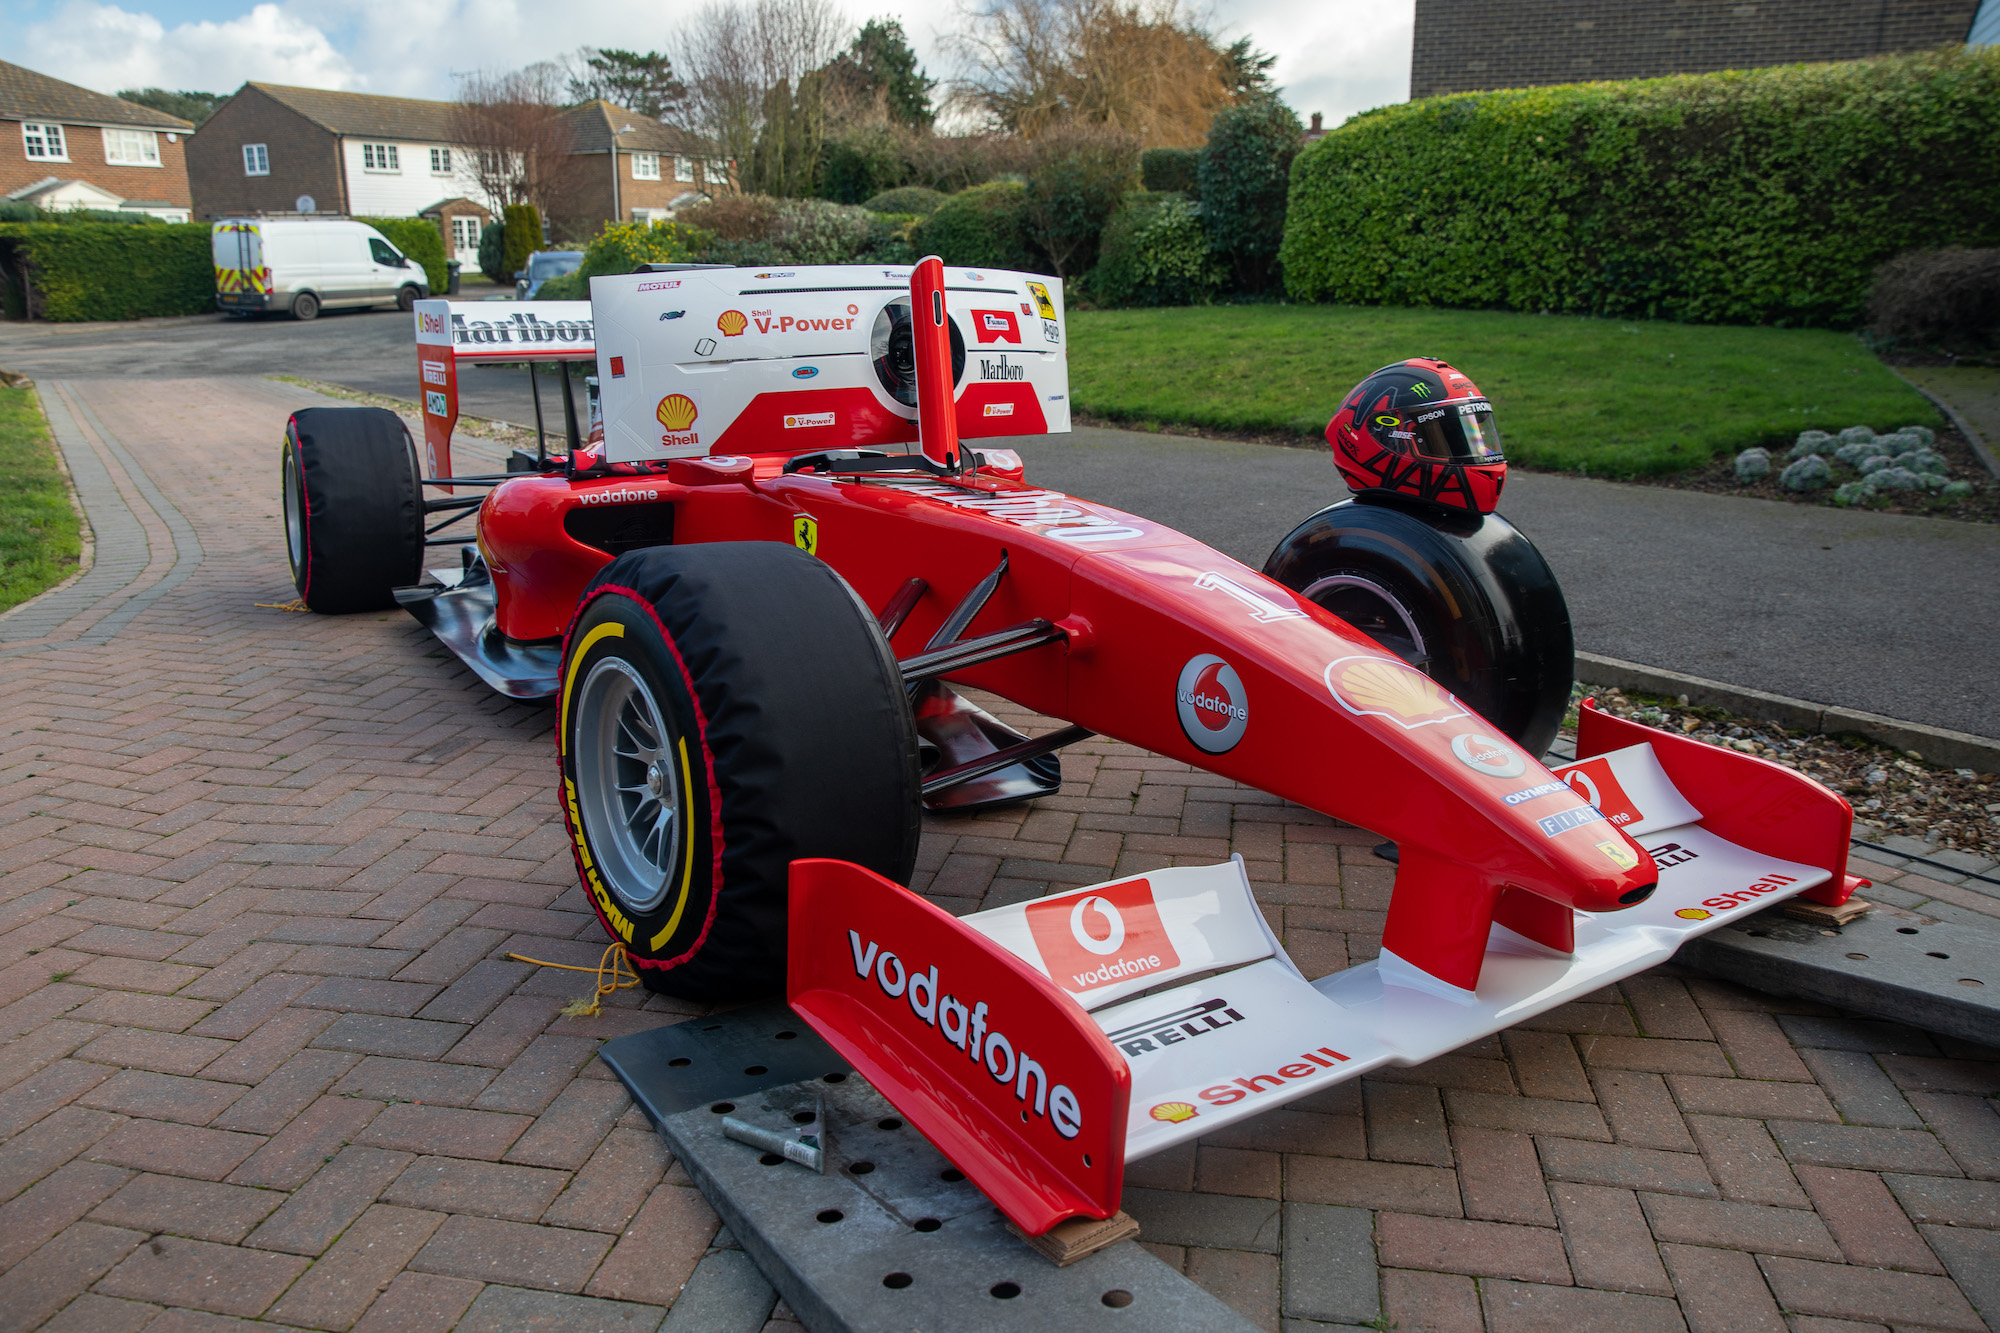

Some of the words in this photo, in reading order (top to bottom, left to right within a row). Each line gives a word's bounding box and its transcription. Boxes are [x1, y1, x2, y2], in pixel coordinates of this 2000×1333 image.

[639, 281, 679, 291] MOTUL
[424, 313, 445, 334] Shell
[752, 309, 772, 317] Shell
[452, 313, 595, 344] arlbor
[754, 316, 854, 334] V-Power
[423, 361, 446, 386] PIRELLI
[980, 355, 1023, 380] Marlboro
[428, 393, 441, 413] AMD
[1458, 402, 1492, 415] PETRON
[1418, 410, 1446, 423] EPSON
[662, 433, 699, 446] Shell
[1388, 430, 1416, 440] BOSE
[579, 487, 658, 505] vodafone
[1193, 571, 1311, 624] 1
[1178, 688, 1247, 721] vodafone
[1464, 747, 1513, 765] vodafone
[1506, 781, 1568, 804] OLYMPUS
[1545, 807, 1600, 833] FIAT
[1702, 873, 1798, 910] Shell
[1073, 952, 1161, 987] vodafone
[848, 928, 1081, 1139] vodafone
[1106, 998, 1246, 1057] PRELLI
[1198, 1047, 1351, 1106] Shell
